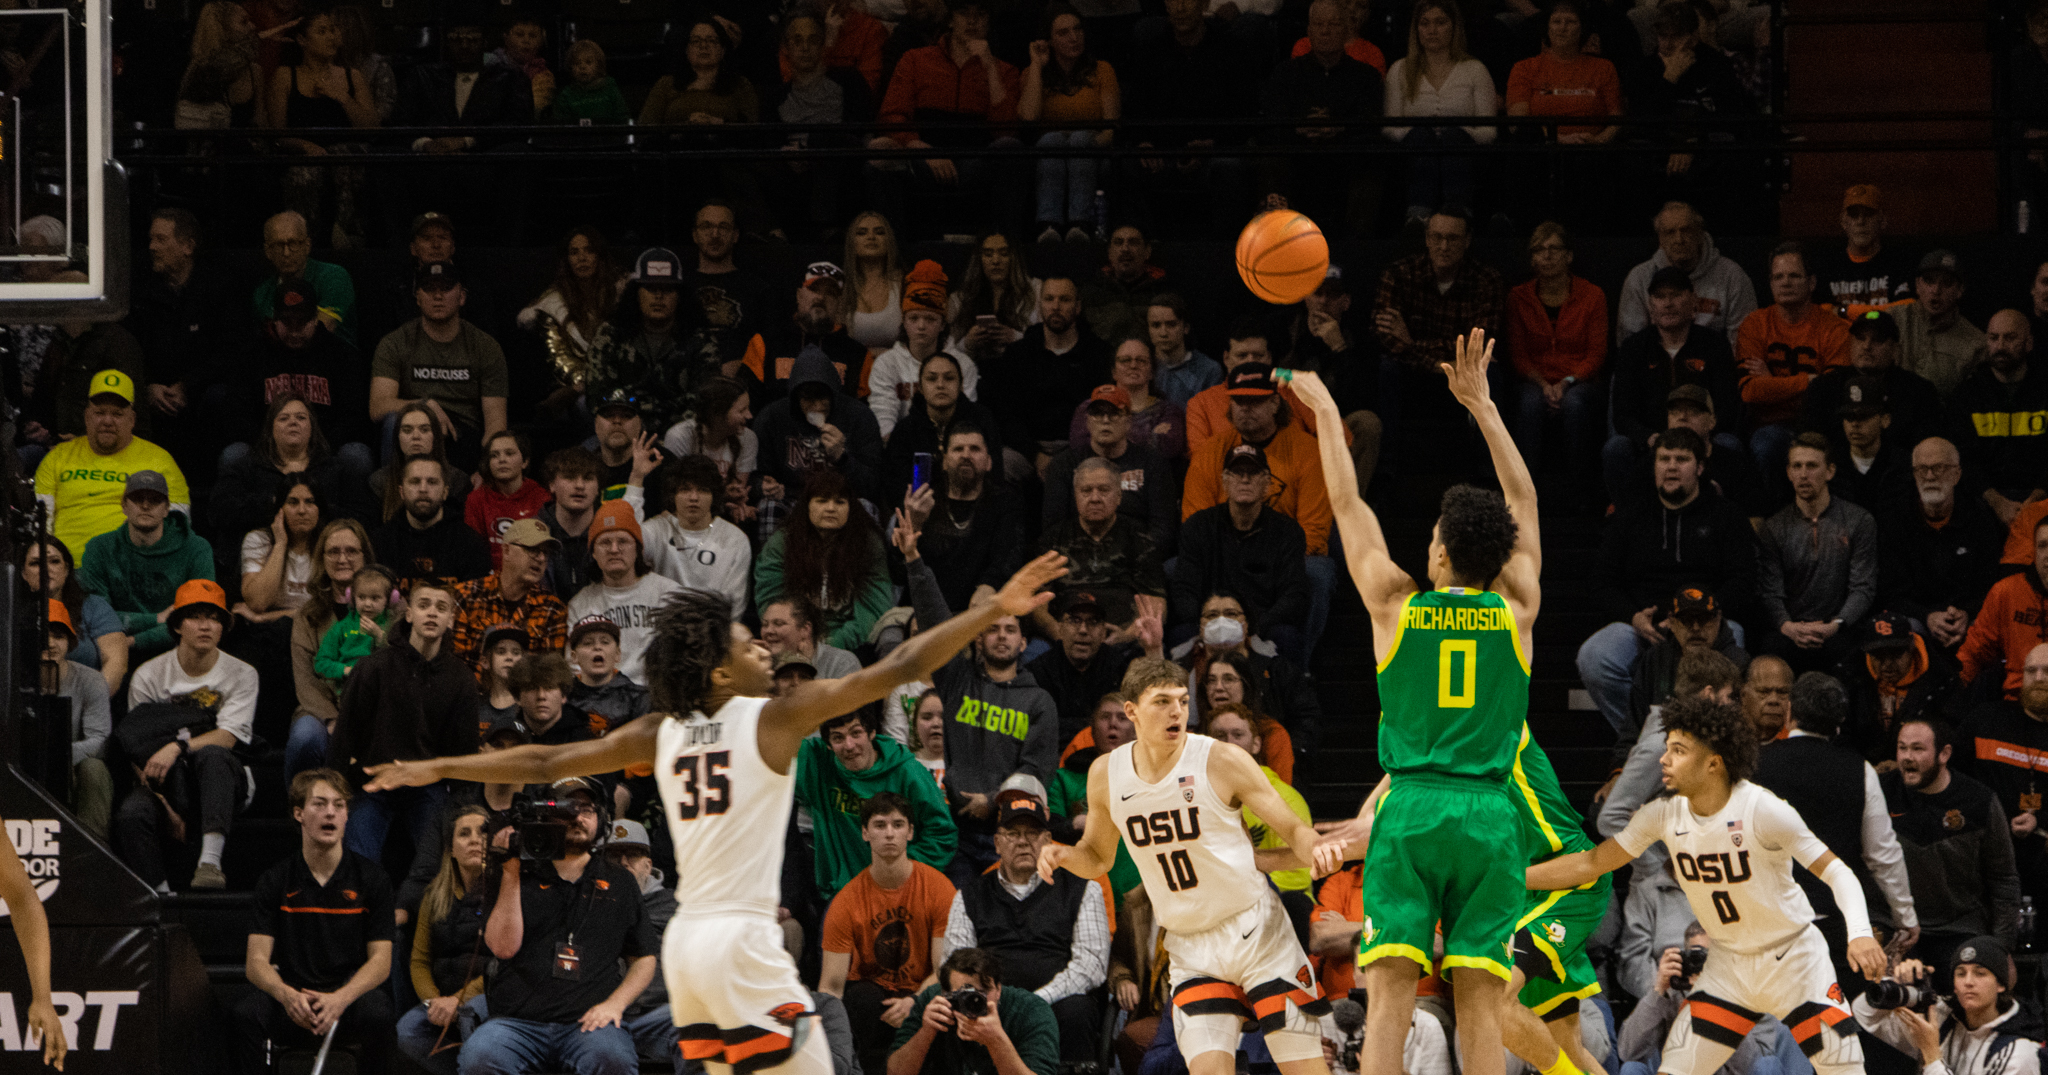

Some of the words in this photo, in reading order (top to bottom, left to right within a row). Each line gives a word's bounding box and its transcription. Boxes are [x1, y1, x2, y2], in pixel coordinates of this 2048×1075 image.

[104, 374, 120, 387] O
[413, 367, 430, 380] NO
[430, 368, 470, 381] EXCUSES
[60, 469, 129, 484] OREGO
[698, 549, 717, 566] O
[1405, 606, 1511, 631] RICHARDSON
[1438, 639, 1477, 708] 0
[674, 750, 731, 820] 35
[1010, 799, 1037, 812] OSU
[1126, 807, 1201, 848] OSU
[1156, 849, 1199, 892] 10
[1676, 850, 1752, 884] OSU
[1711, 890, 1741, 925] 0
